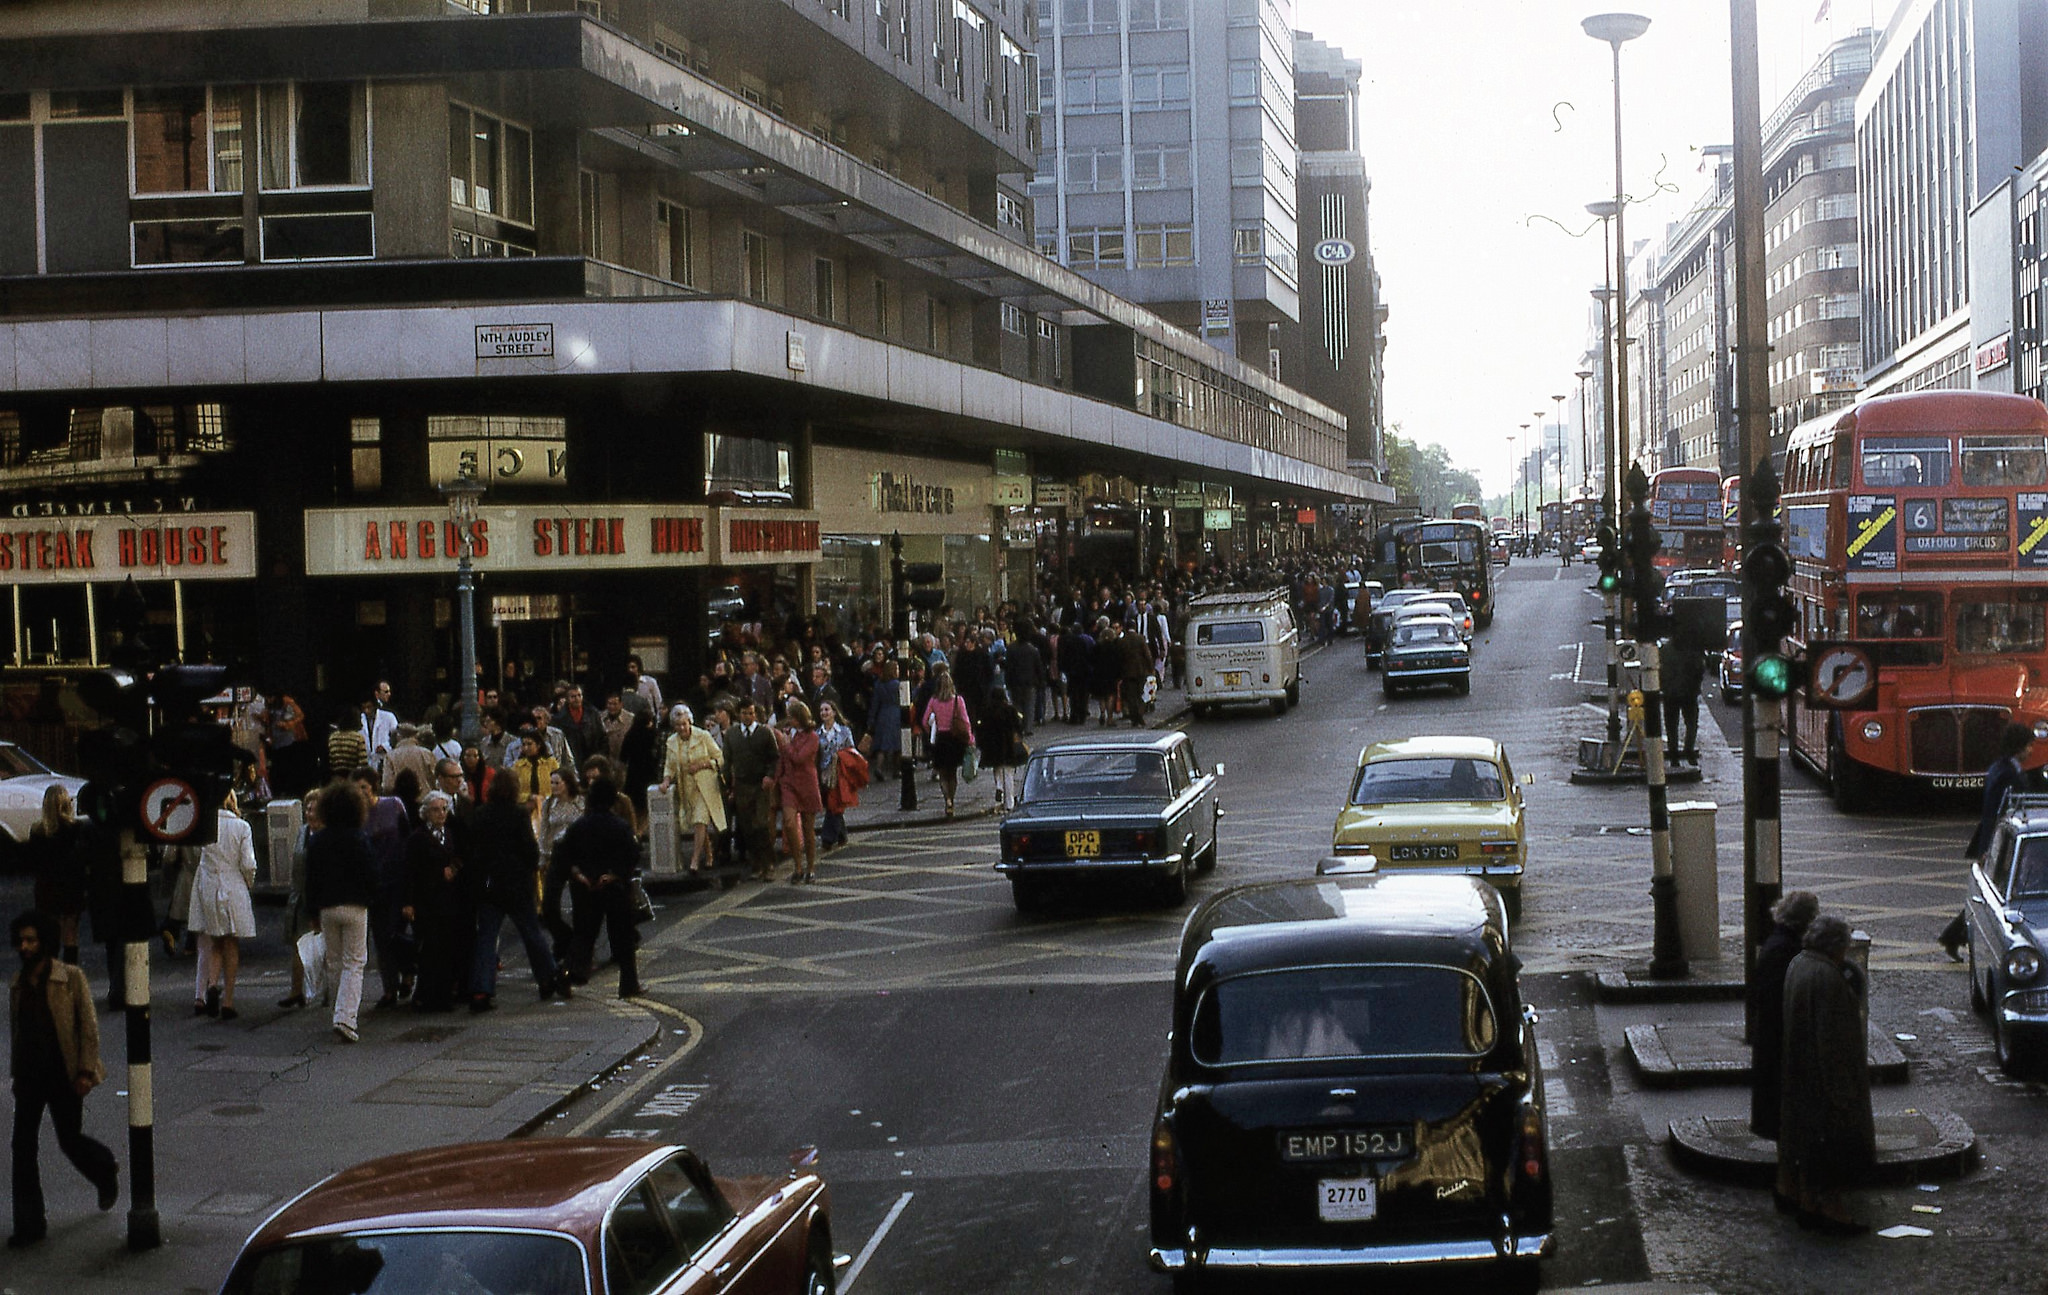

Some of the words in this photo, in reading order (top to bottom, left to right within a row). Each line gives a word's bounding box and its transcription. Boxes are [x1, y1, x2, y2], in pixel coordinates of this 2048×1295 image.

[1321, 244, 1347, 259] C&A
[507, 331, 549, 342] AUDLEY
[495, 344, 535, 354] STREET
[1914, 507, 1928, 529] 6
[364, 518, 489, 560] ANGUS
[533, 517, 626, 556] STEAK
[1917, 537, 1957, 549] OXFORD
[1964, 537, 1997, 549] CIRCUS
[0, 528, 95, 571] STEAK
[118, 525, 228, 568] HOUSE
[1932, 778, 1953, 788] CUV
[1288, 1135, 1337, 1157] EMP
[1344, 1131, 1402, 1155] 152J
[1327, 1187, 1367, 1203] 2770
